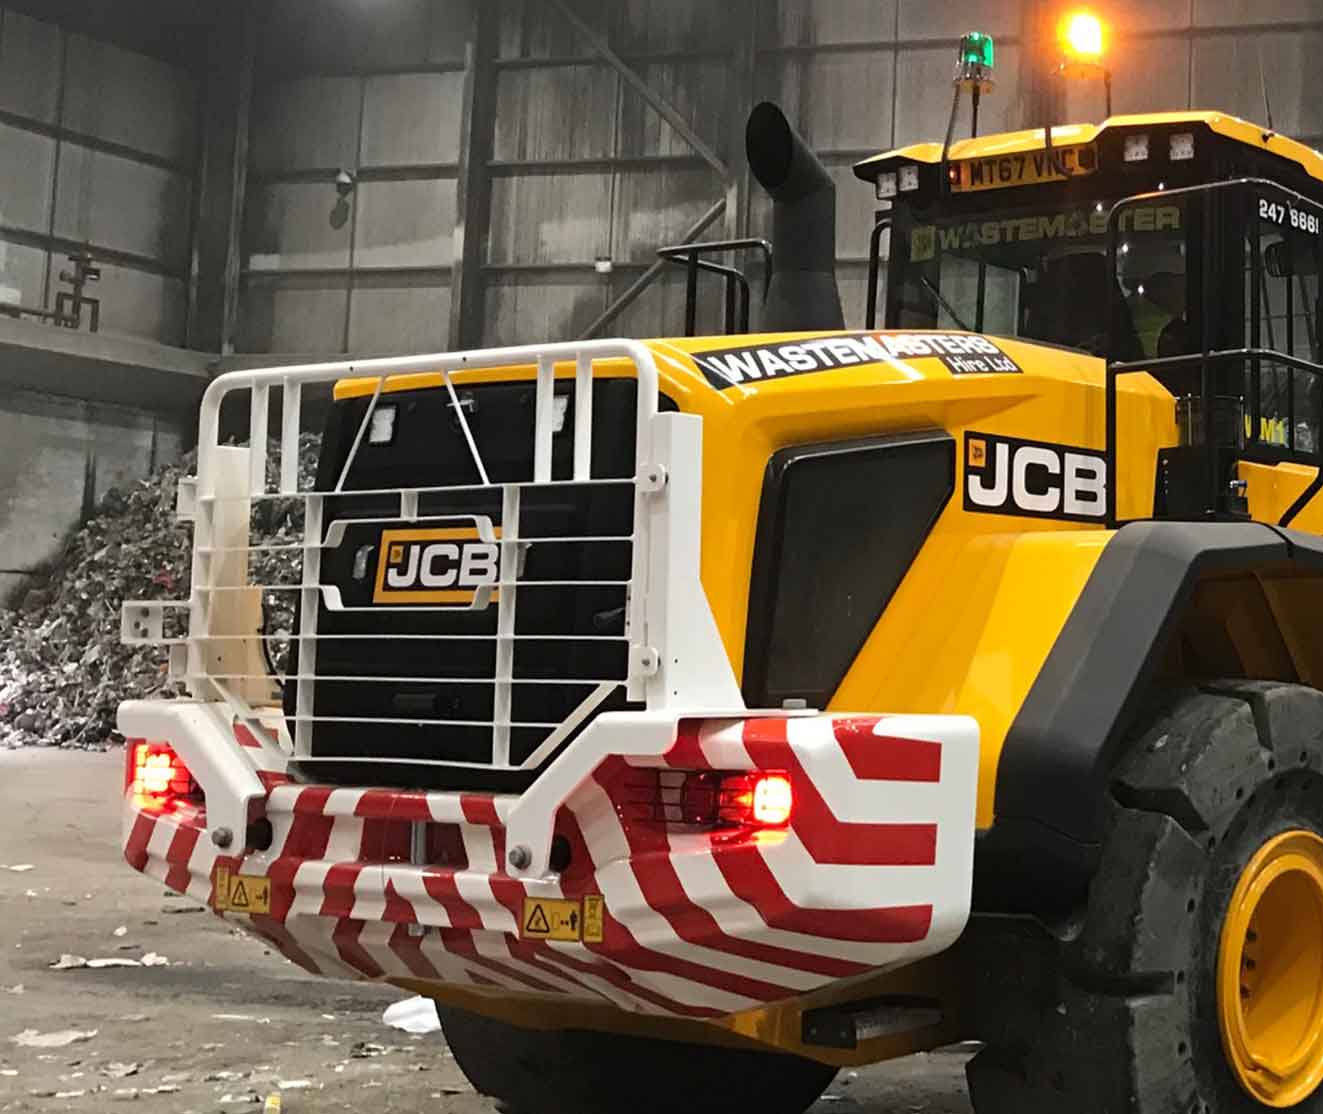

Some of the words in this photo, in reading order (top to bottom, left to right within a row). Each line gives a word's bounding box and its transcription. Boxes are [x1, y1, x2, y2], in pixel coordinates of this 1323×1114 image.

[969, 156, 1025, 186] MT67
[1259, 199, 1285, 224] 247
[707, 333, 995, 383] WASTEMASTERS
[946, 356, 989, 373] Hire
[983, 355, 1018, 373] Ltd
[967, 442, 1107, 517] JCB
[387, 543, 499, 587] JCB
